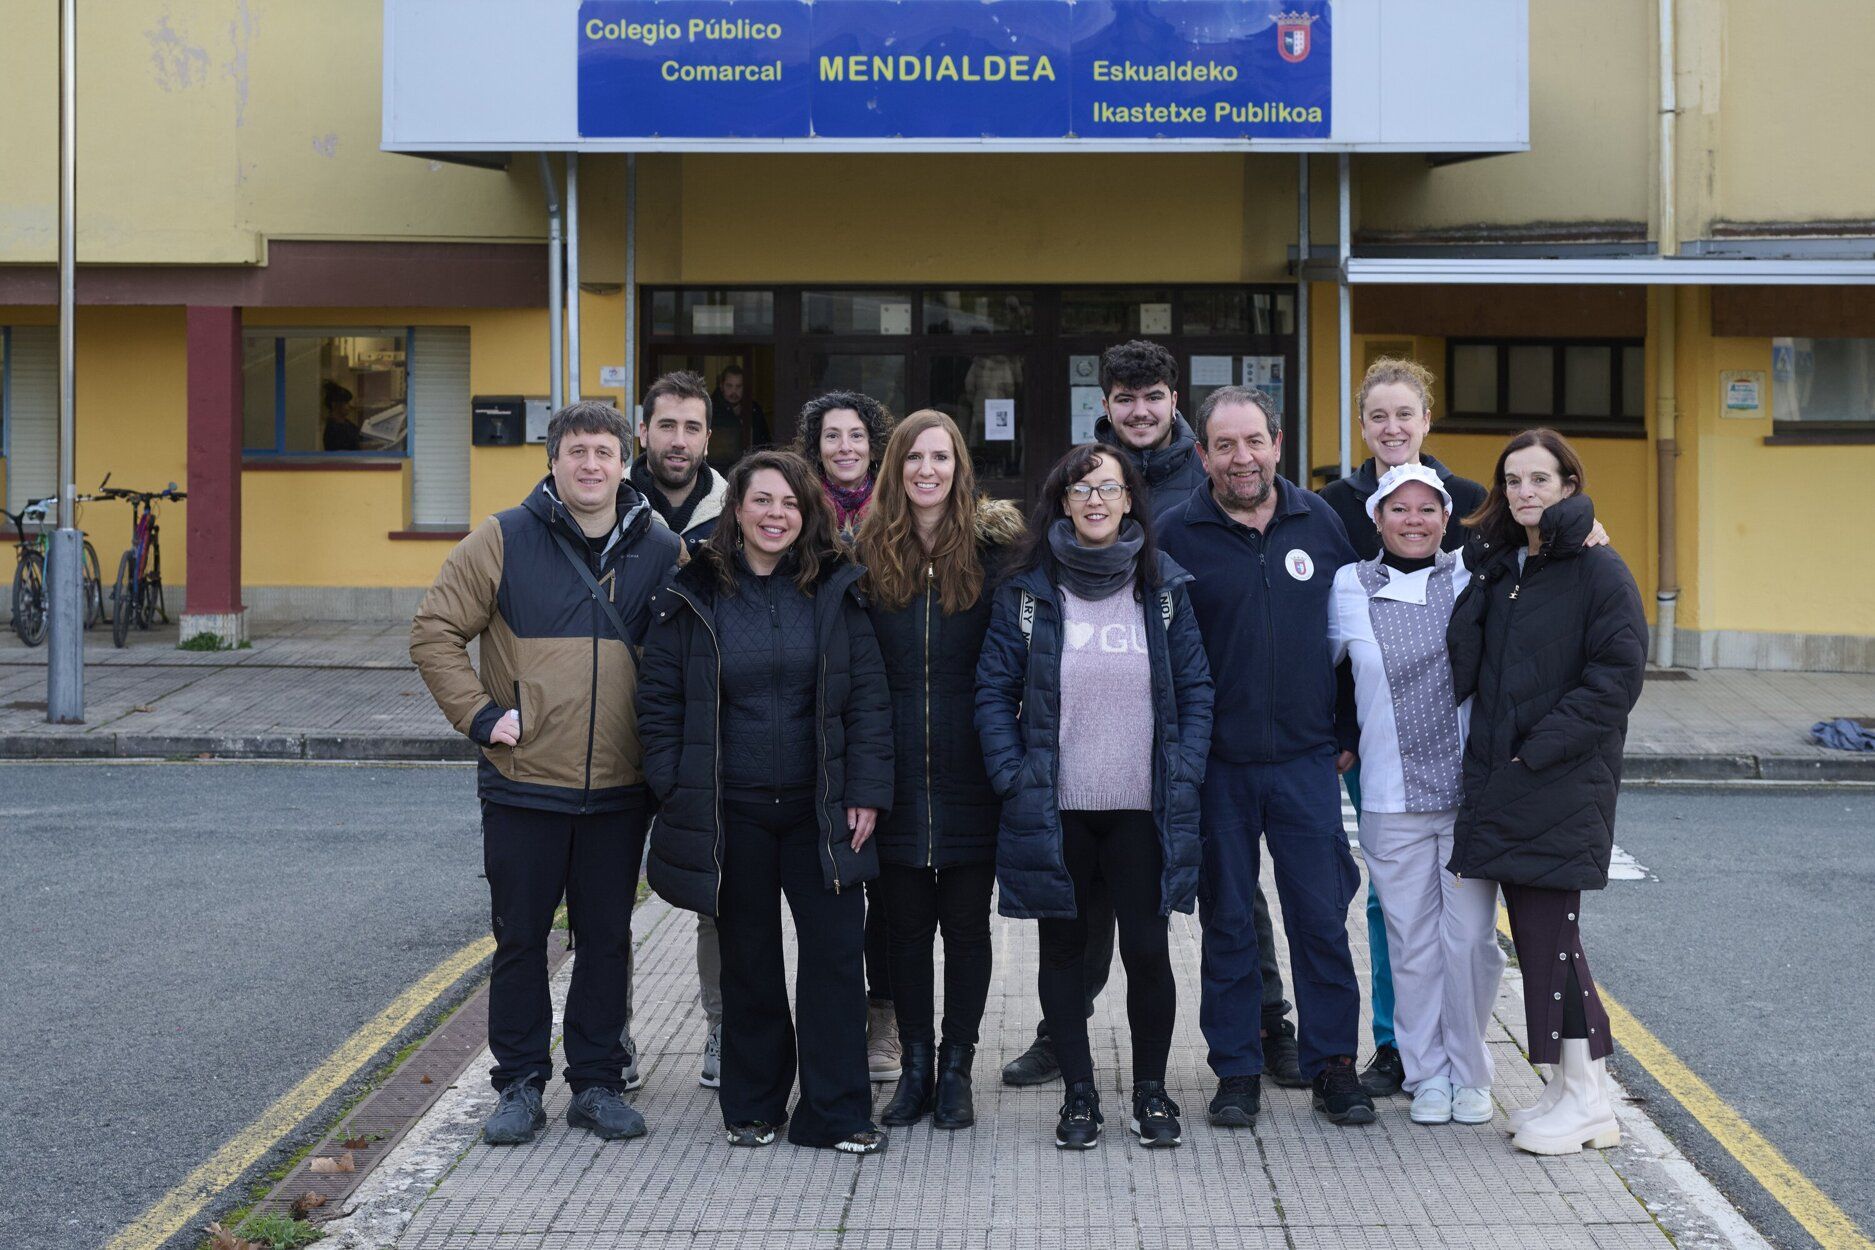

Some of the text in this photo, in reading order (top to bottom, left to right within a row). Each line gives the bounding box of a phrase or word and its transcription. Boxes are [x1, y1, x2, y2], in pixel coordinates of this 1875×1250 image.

[585, 18, 782, 46] Colegio Público
[661, 60, 782, 81] Comarcal
[819, 55, 1056, 82] MENDIALDEA
[1093, 60, 1238, 81] Eskualdeko
[1093, 102, 1322, 123] Ikastetxe Publikoa
[1160, 595, 1171, 620] NOT
